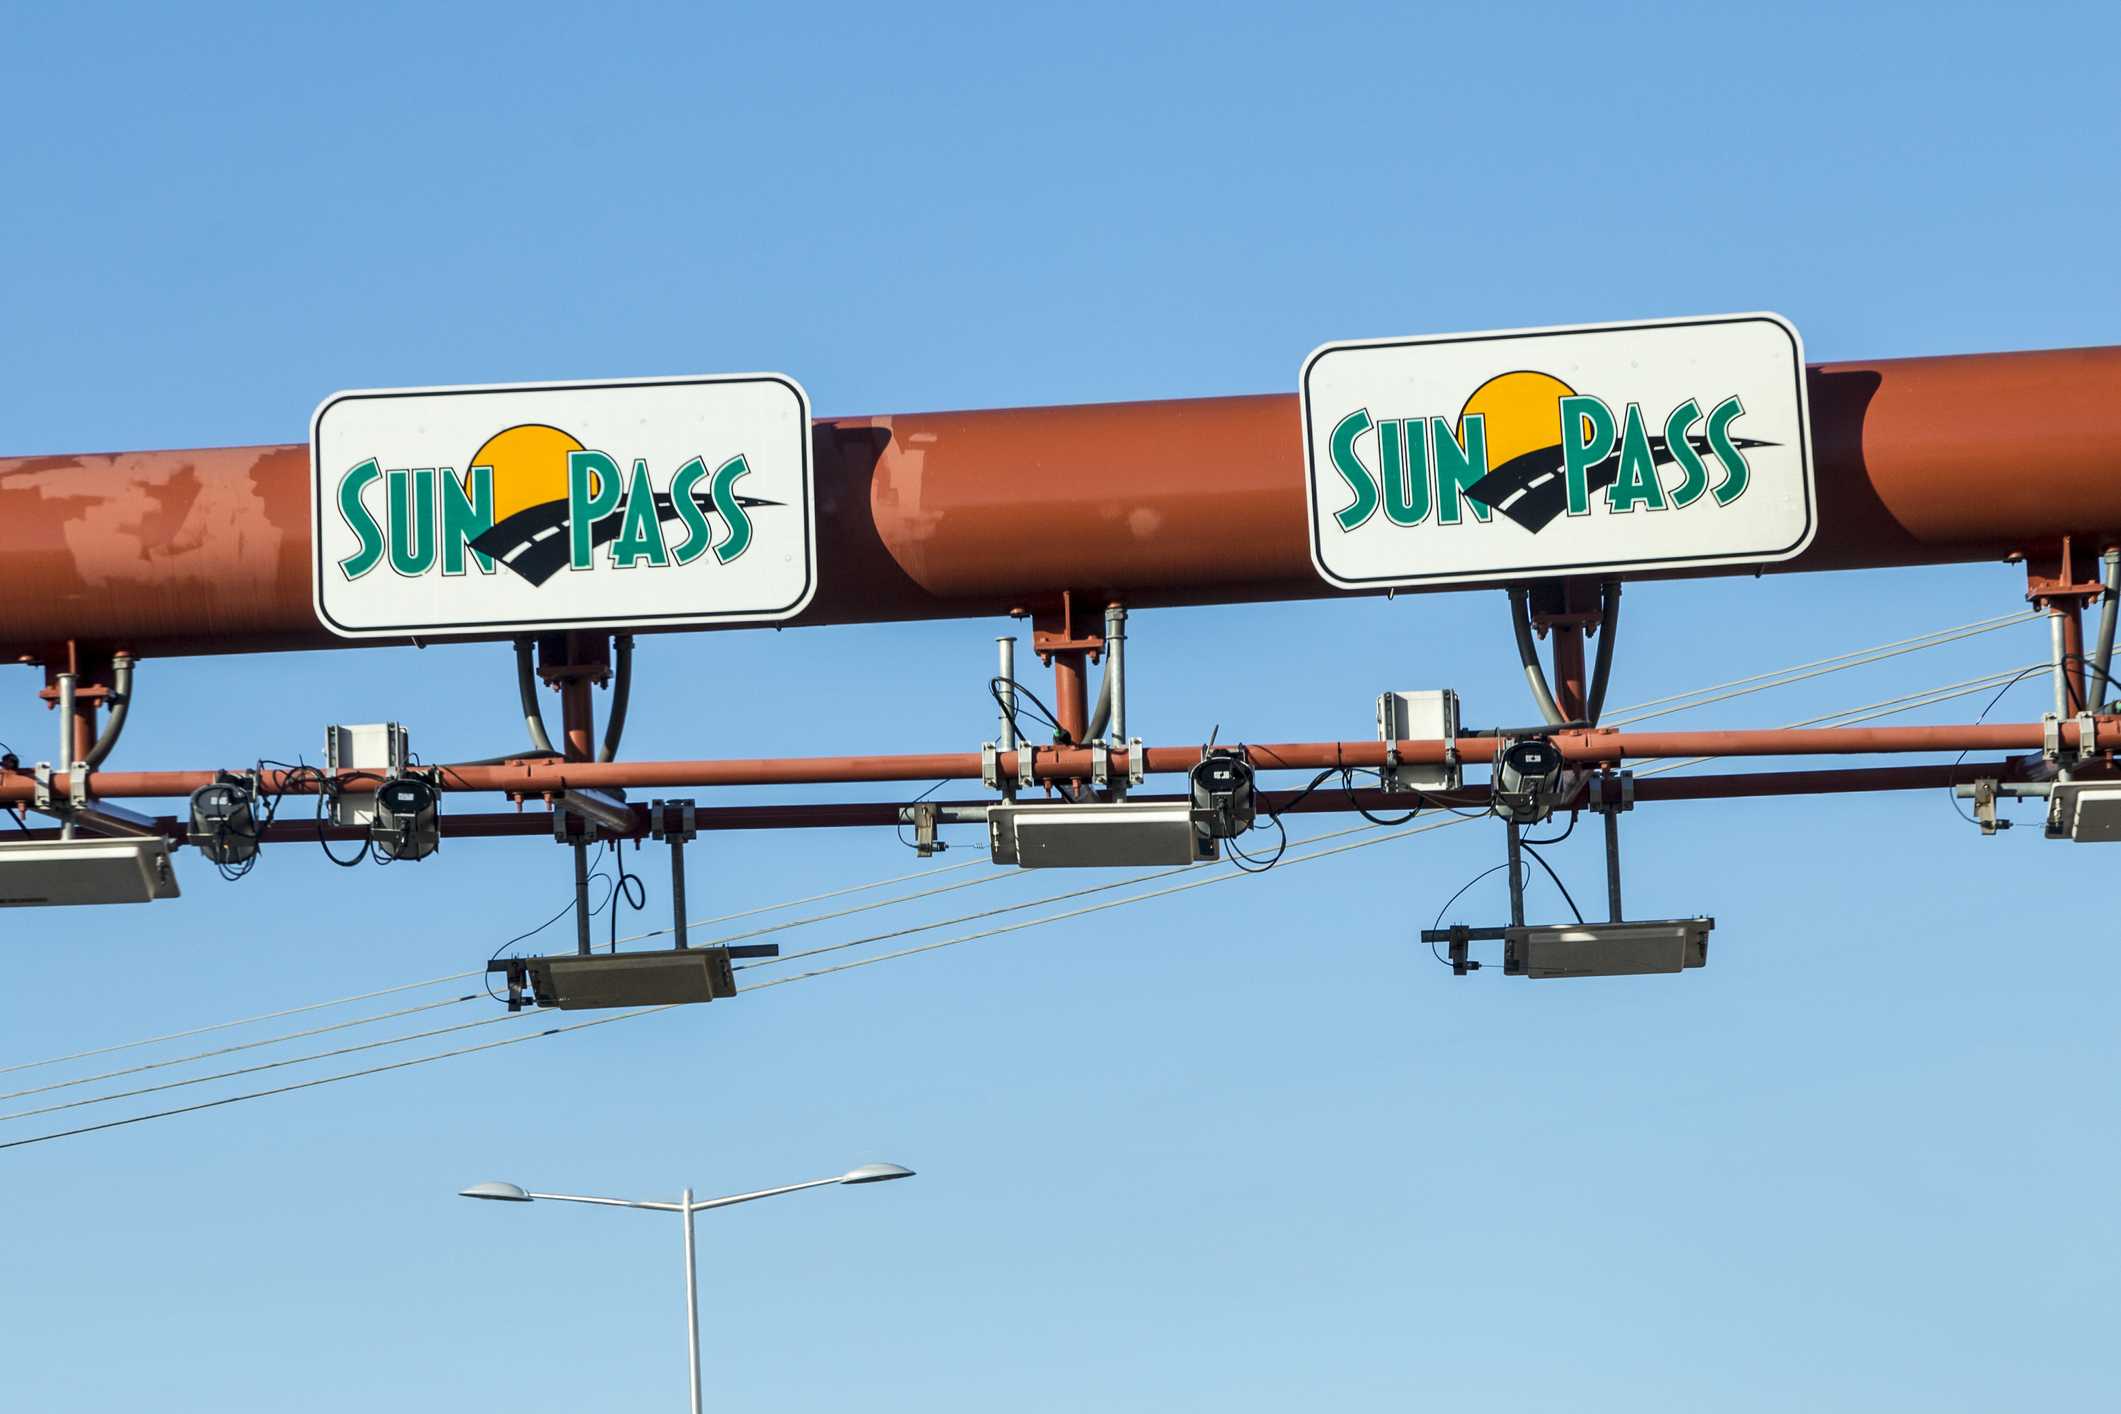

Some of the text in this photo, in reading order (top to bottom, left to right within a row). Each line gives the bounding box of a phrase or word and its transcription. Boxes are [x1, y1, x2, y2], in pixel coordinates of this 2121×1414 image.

[337, 449, 753, 581] SUN PASS
[1329, 394, 1750, 533] SUN PASS
